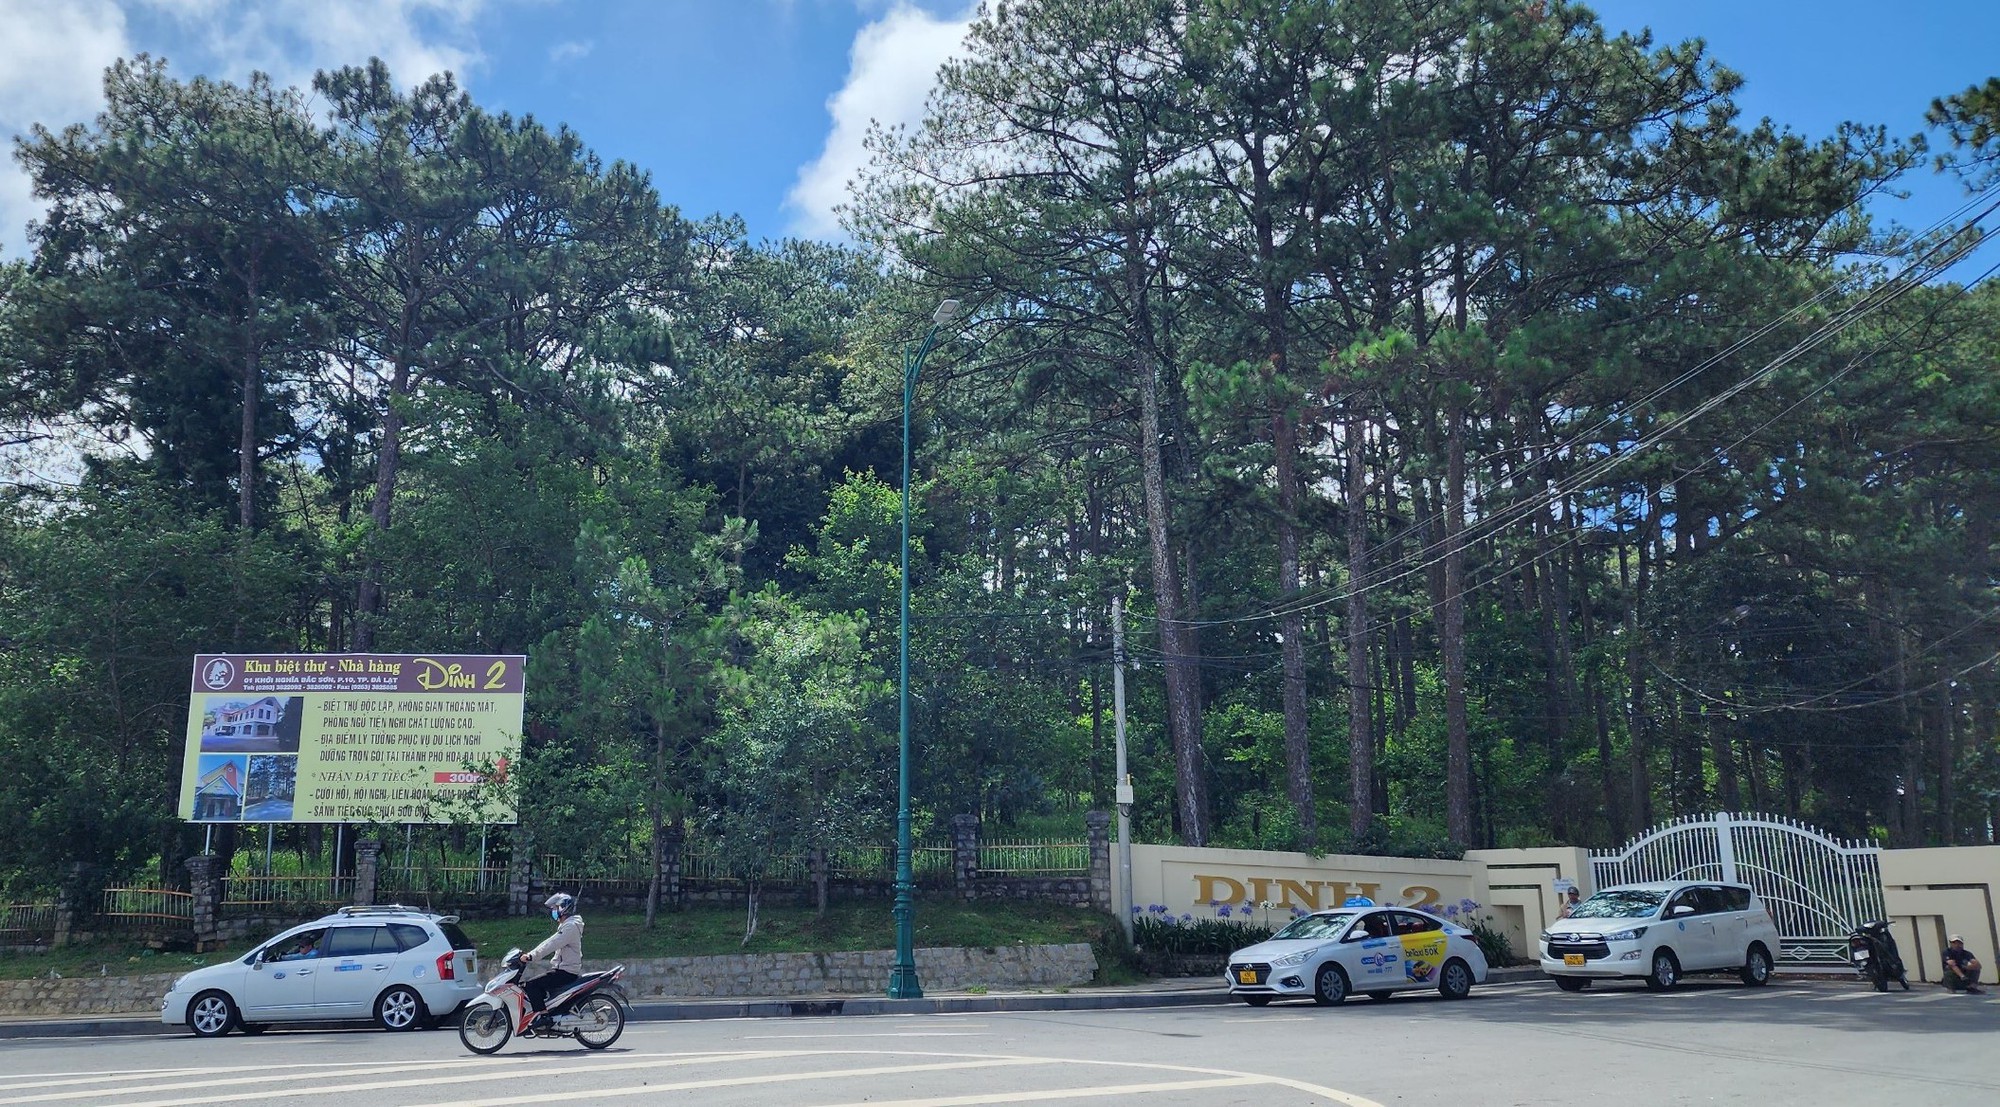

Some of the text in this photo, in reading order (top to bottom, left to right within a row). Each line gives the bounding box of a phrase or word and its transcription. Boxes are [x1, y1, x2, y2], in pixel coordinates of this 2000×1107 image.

[244, 660, 271, 673] Khu
[275, 660, 300, 675] biệt
[304, 659, 327, 675] thự
[338, 659, 364, 673] Nhà
[368, 660, 401, 676] hàng
[483, 660, 507, 690] 2
[425, 701, 443, 712] GIAN
[388, 717, 406, 728] NGHI
[432, 734, 443, 745] DU
[445, 734, 462, 748] LỊCH
[1193, 874, 1444, 910] DINH 2
[1424, 947, 1439, 956] 50K
